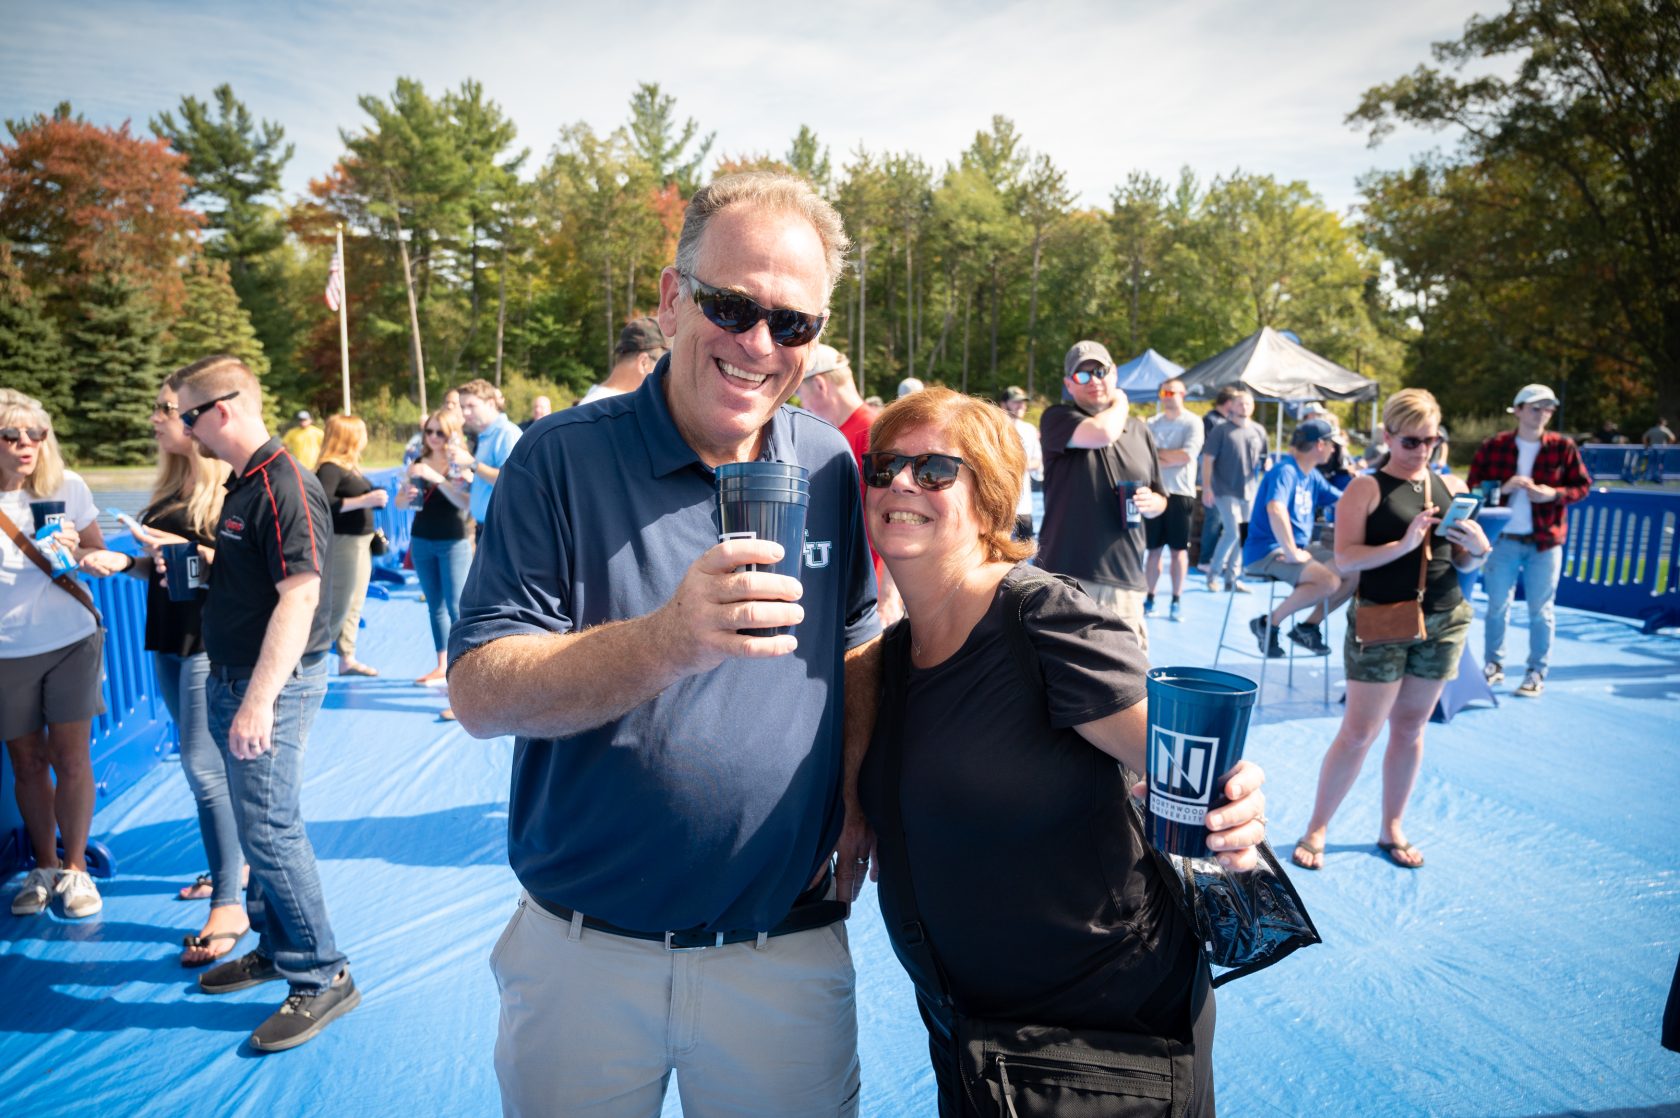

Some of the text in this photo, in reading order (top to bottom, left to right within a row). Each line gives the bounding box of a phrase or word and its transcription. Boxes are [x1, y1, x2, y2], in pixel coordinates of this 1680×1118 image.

[803, 528, 832, 568] U
[1151, 795, 1204, 815] NORTHWOOD
[1151, 804, 1203, 822] UNIVERSITY
